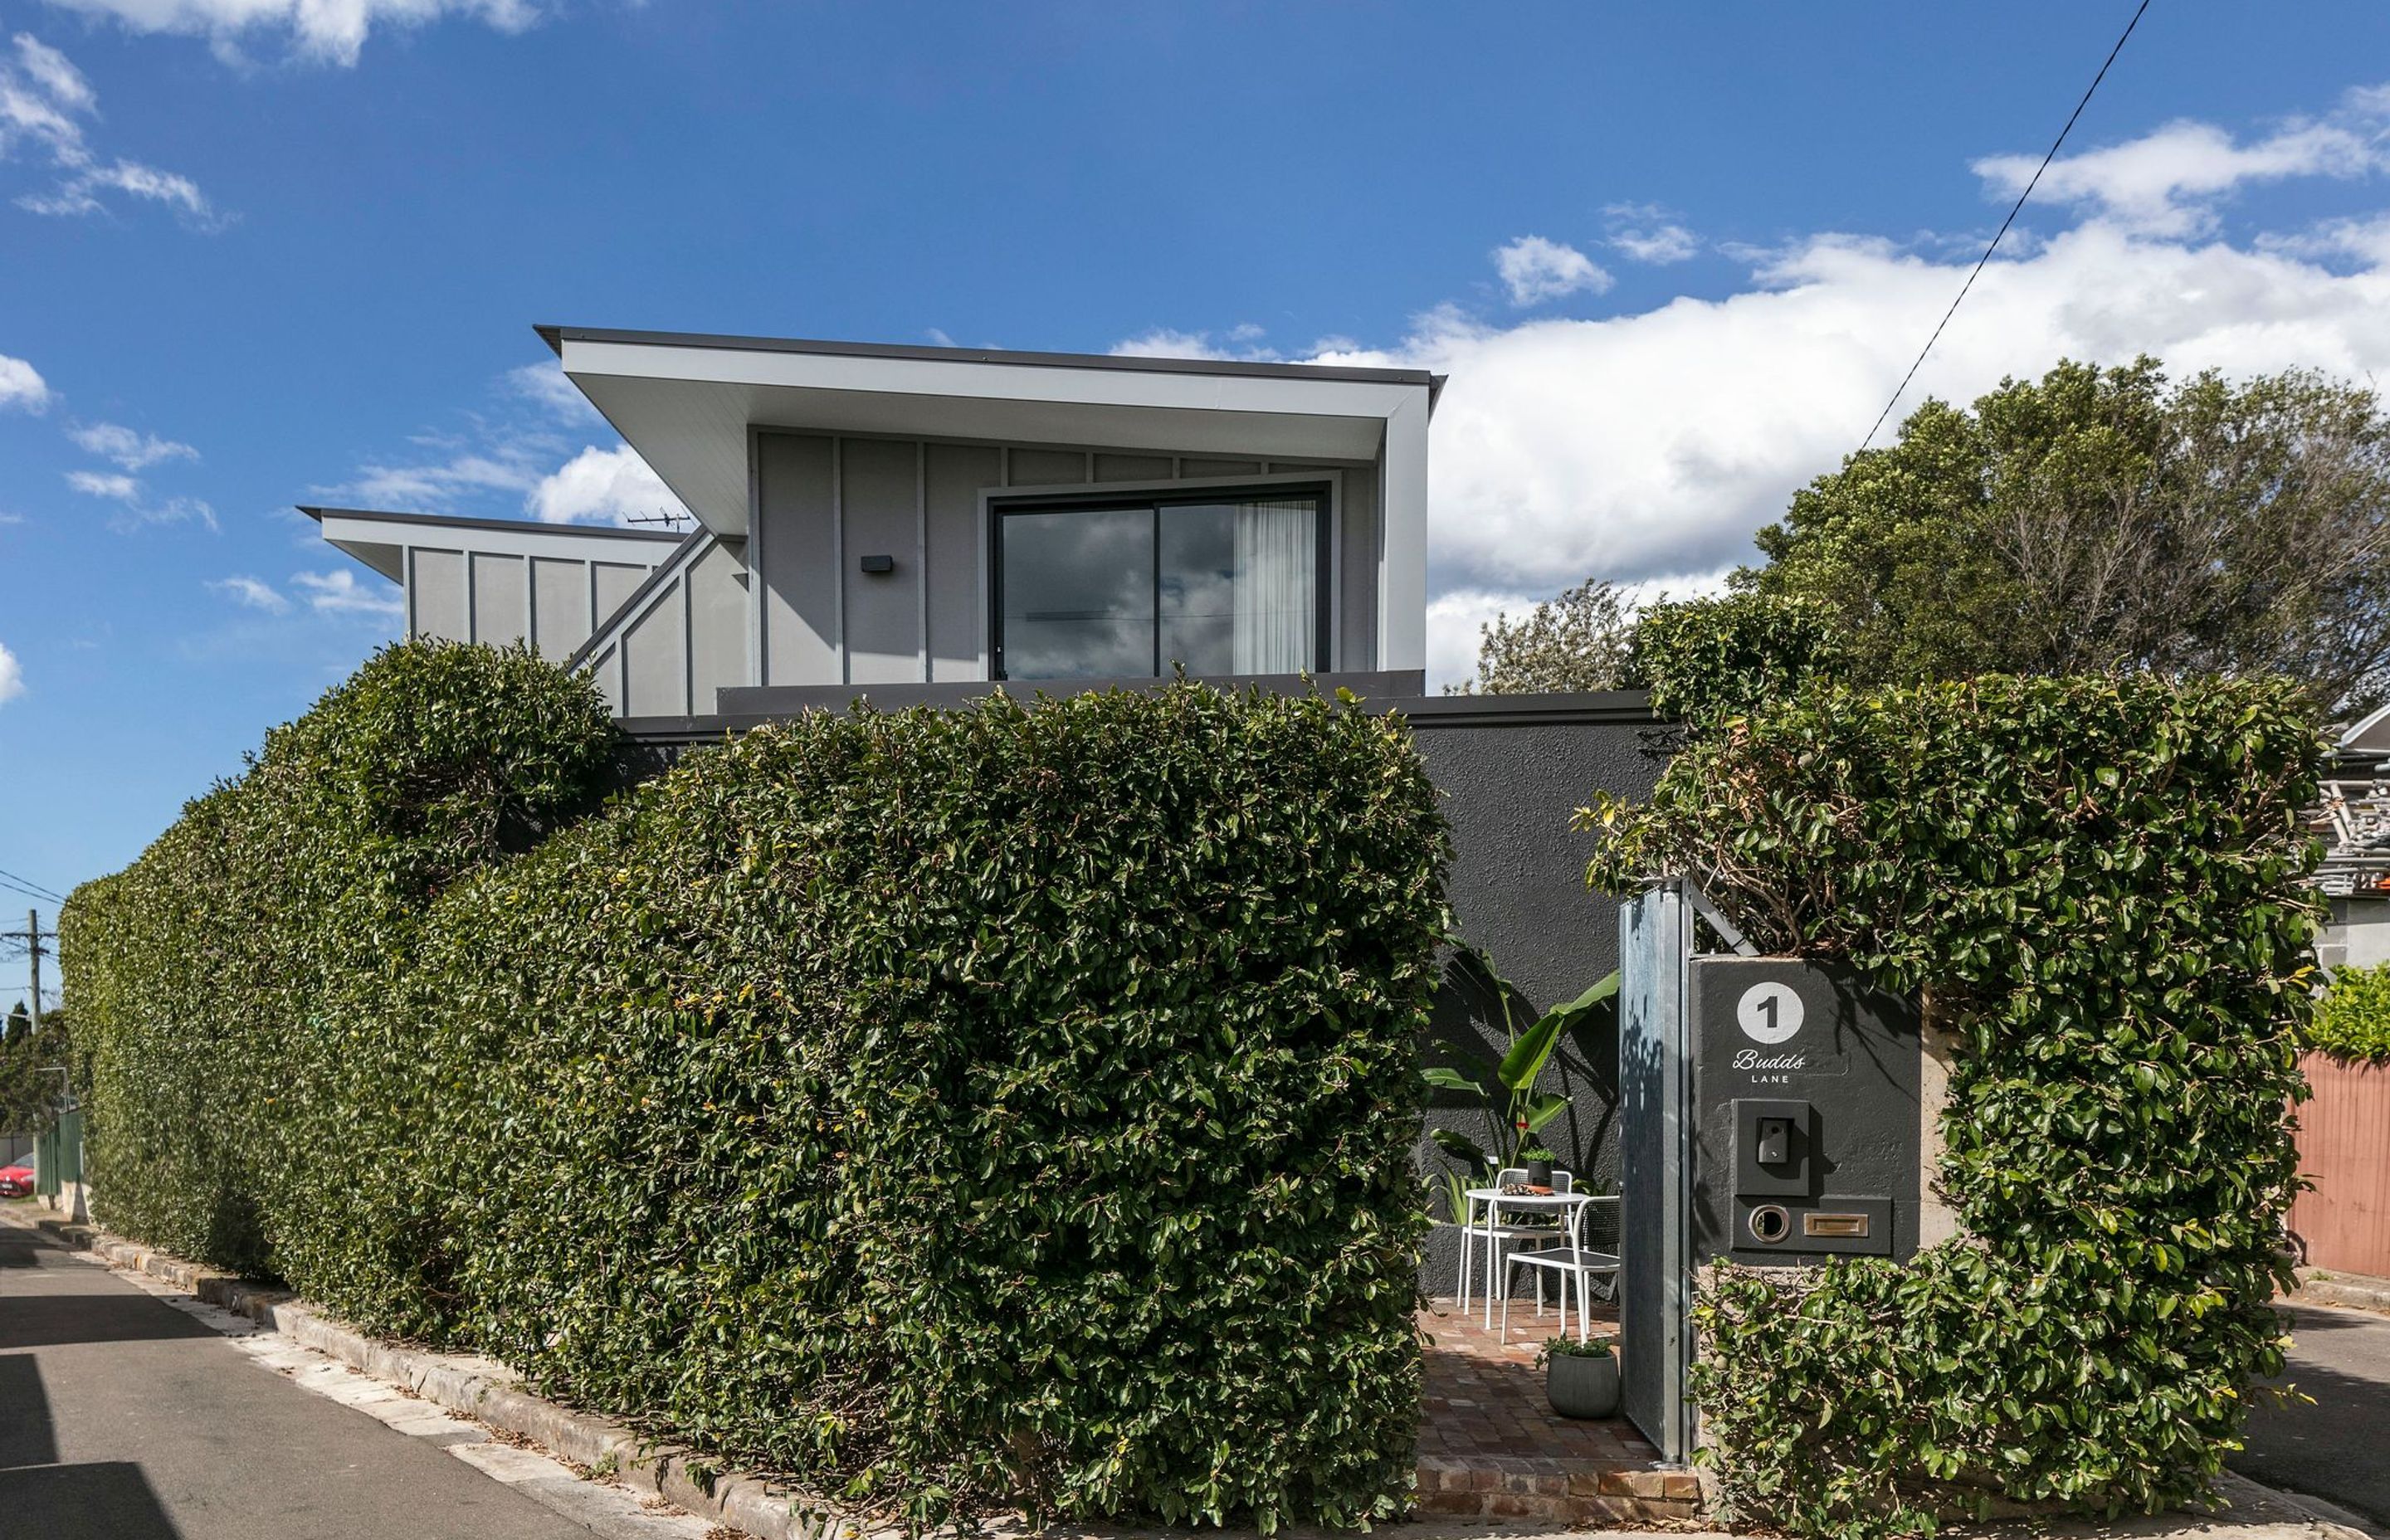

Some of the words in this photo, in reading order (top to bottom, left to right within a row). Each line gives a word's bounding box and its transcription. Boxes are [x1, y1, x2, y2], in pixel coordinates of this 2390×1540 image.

[1757, 996, 1778, 1028] 1
[1733, 1049, 1805, 1070] Budds
[1751, 1075, 1789, 1084] LANE
